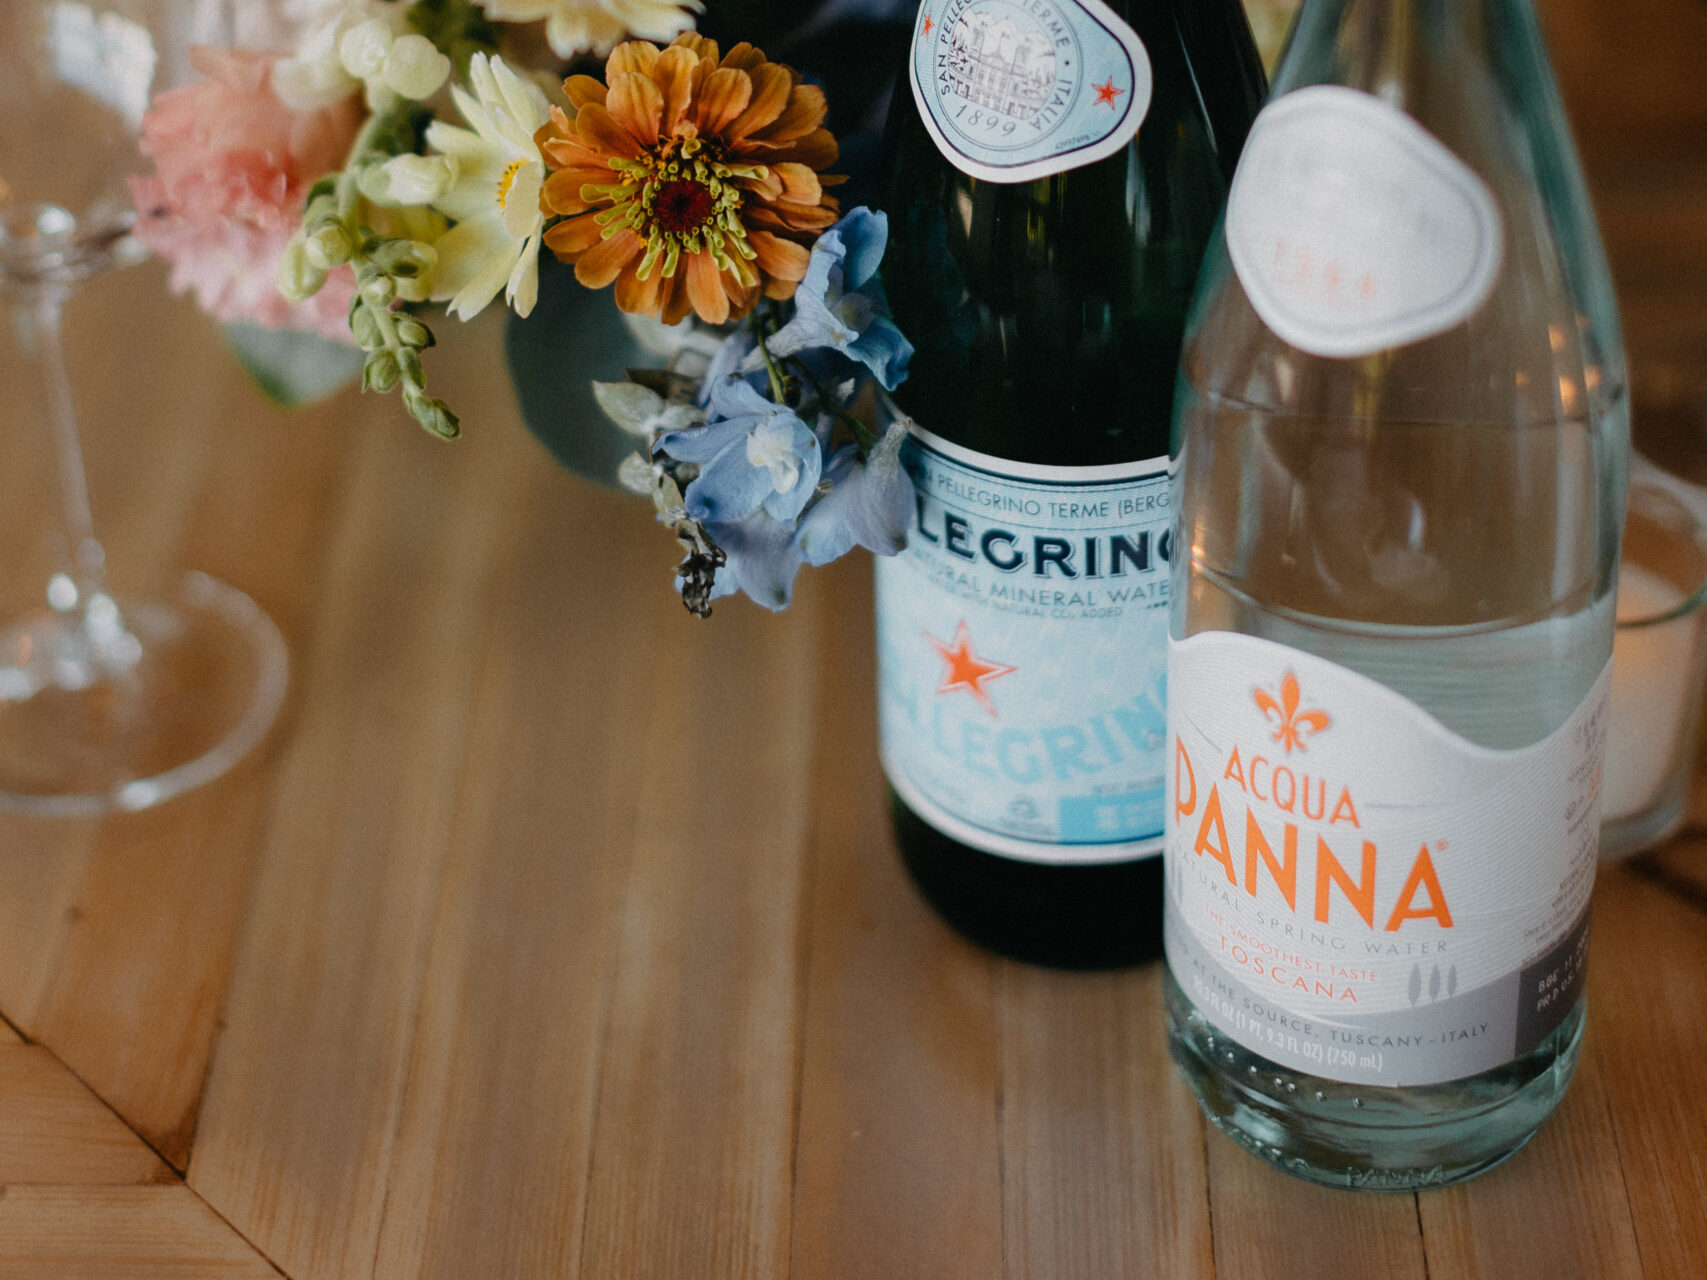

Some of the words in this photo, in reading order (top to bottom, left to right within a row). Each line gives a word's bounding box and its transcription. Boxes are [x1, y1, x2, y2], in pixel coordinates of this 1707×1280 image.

[937, 54, 951, 97] SAN
[1030, 78, 1073, 131] ITALIA
[955, 104, 1017, 137] 1899
[937, 473, 1041, 516] PELLEGRINO
[1048, 501, 1109, 519] TERME
[916, 494, 1169, 579] LEGRIN
[990, 582, 1097, 606] MINERAL
[1223, 744, 1361, 828] ACQUA
[1176, 731, 1455, 932] PANNA
[1229, 923, 1321, 973] SMOOTHEST
[1329, 965, 1377, 982] TASTE
[1256, 911, 1346, 950] SPRING
[1364, 940, 1448, 956] WATER
[1219, 934, 1358, 1004] TOSCANA
[1212, 975, 1235, 1000] THE
[1331, 1030, 1423, 1047] TUSCANY
[1441, 1022, 1488, 1044] ITALY
[1327, 1045, 1356, 1066] (750
